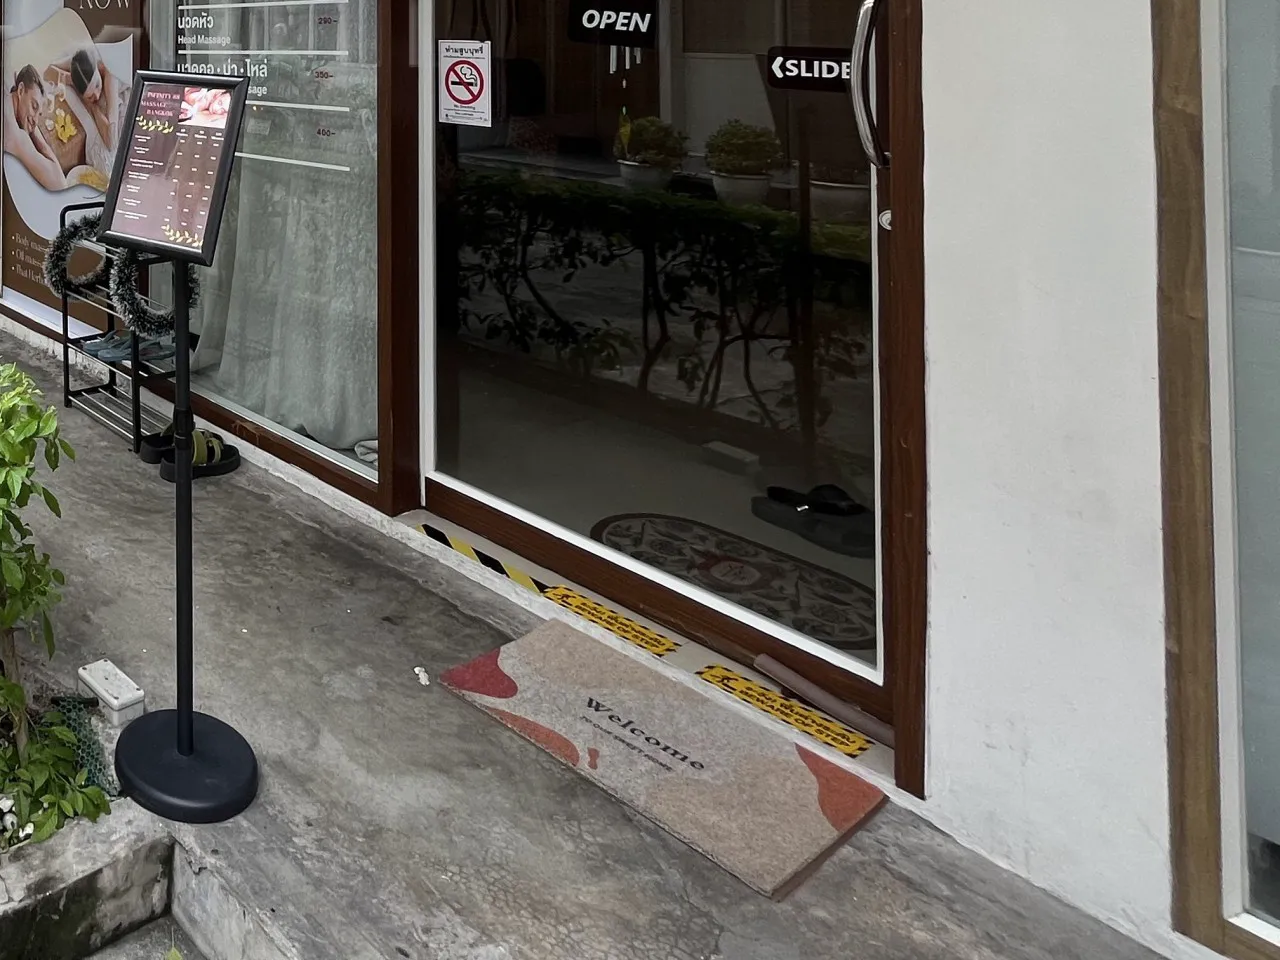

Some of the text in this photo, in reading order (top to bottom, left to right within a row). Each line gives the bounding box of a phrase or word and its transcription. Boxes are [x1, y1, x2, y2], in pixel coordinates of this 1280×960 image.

[177, 12, 214, 29] นวดหัว
[581, 9, 652, 33] OPEN
[178, 34, 232, 46] Head Massage
[574, 604, 616, 627] BEWARE
[616, 625, 631, 634] OF
[738, 689, 850, 747] BEWARE OF STEP
[586, 696, 705, 771] Welcome
